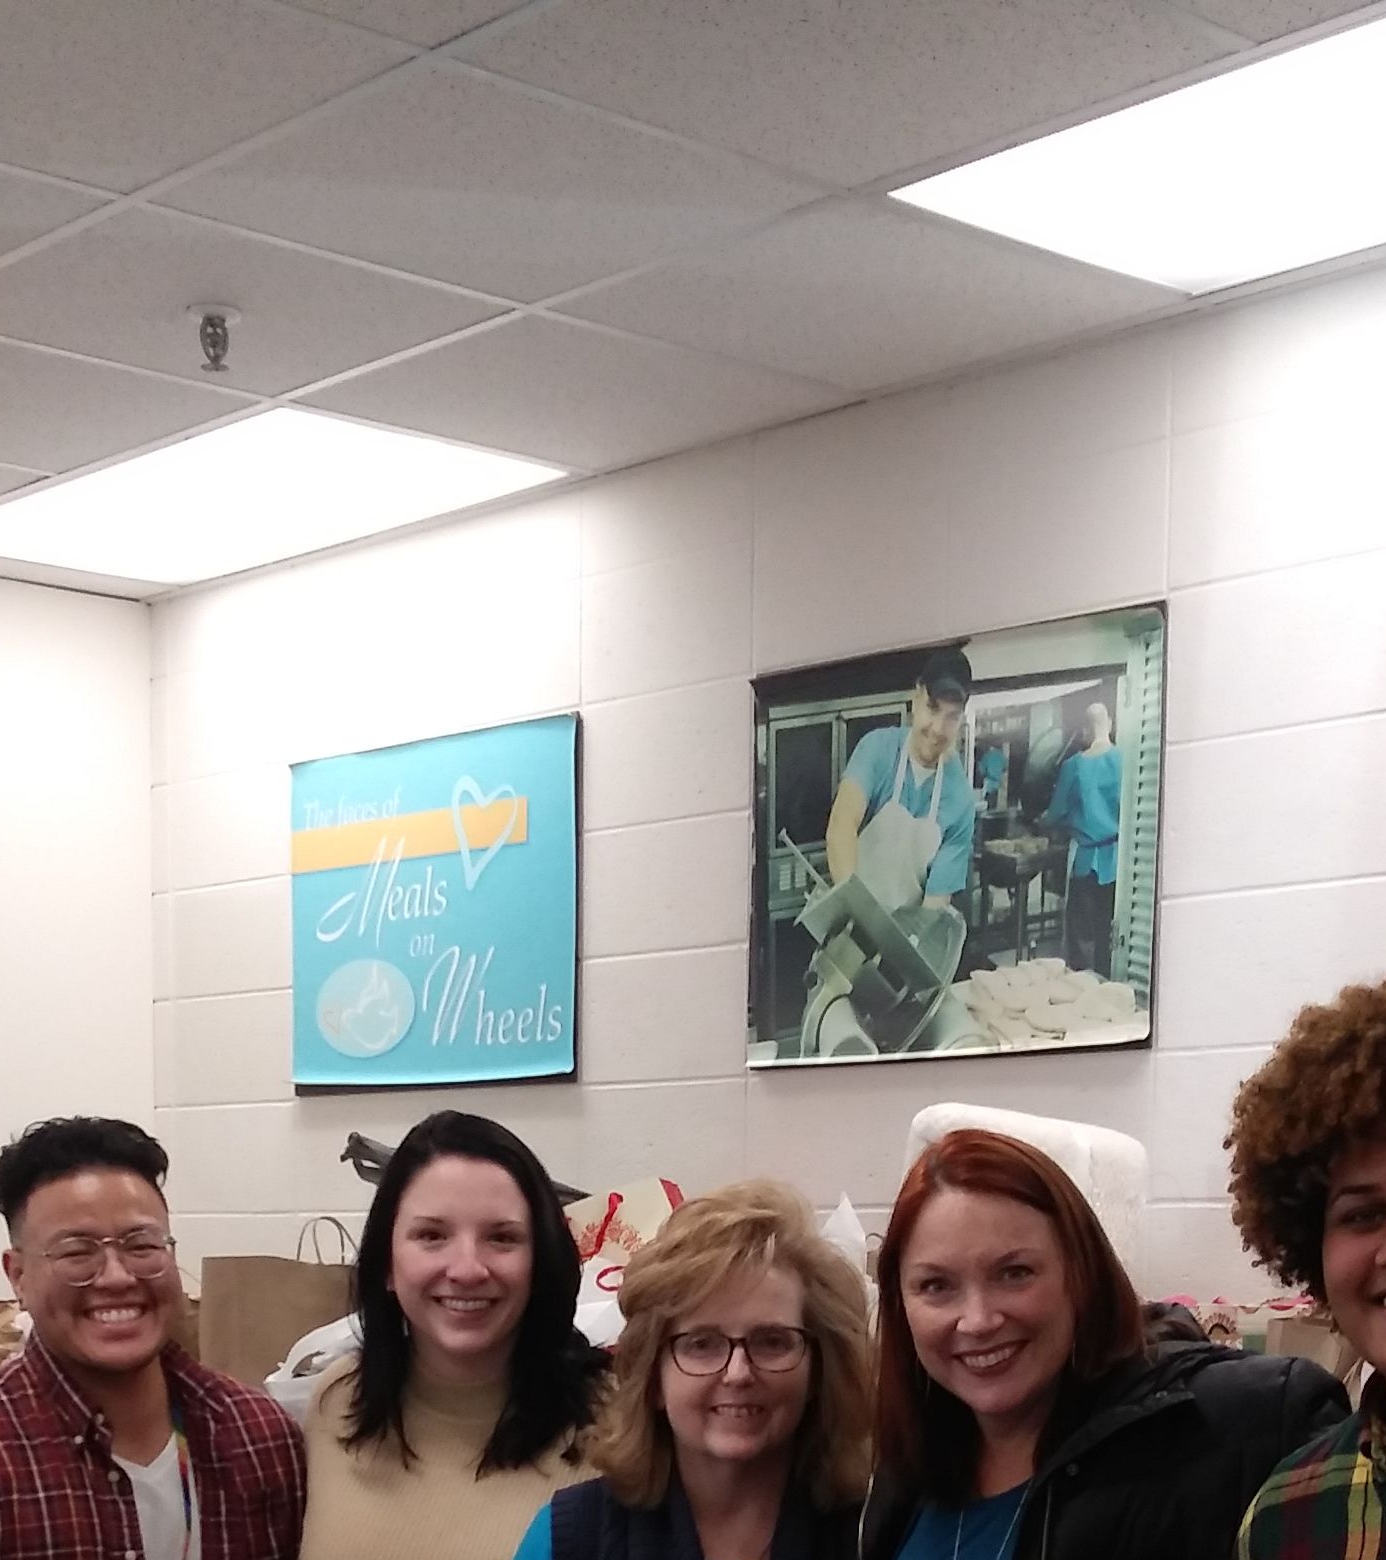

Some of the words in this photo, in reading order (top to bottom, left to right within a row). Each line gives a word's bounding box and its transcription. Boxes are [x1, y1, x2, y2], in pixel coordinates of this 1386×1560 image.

[303, 801, 333, 831] The
[382, 785, 402, 824] of
[316, 836, 448, 948] Meals
[410, 932, 435, 957] on
[422, 945, 562, 1046] Wheels
